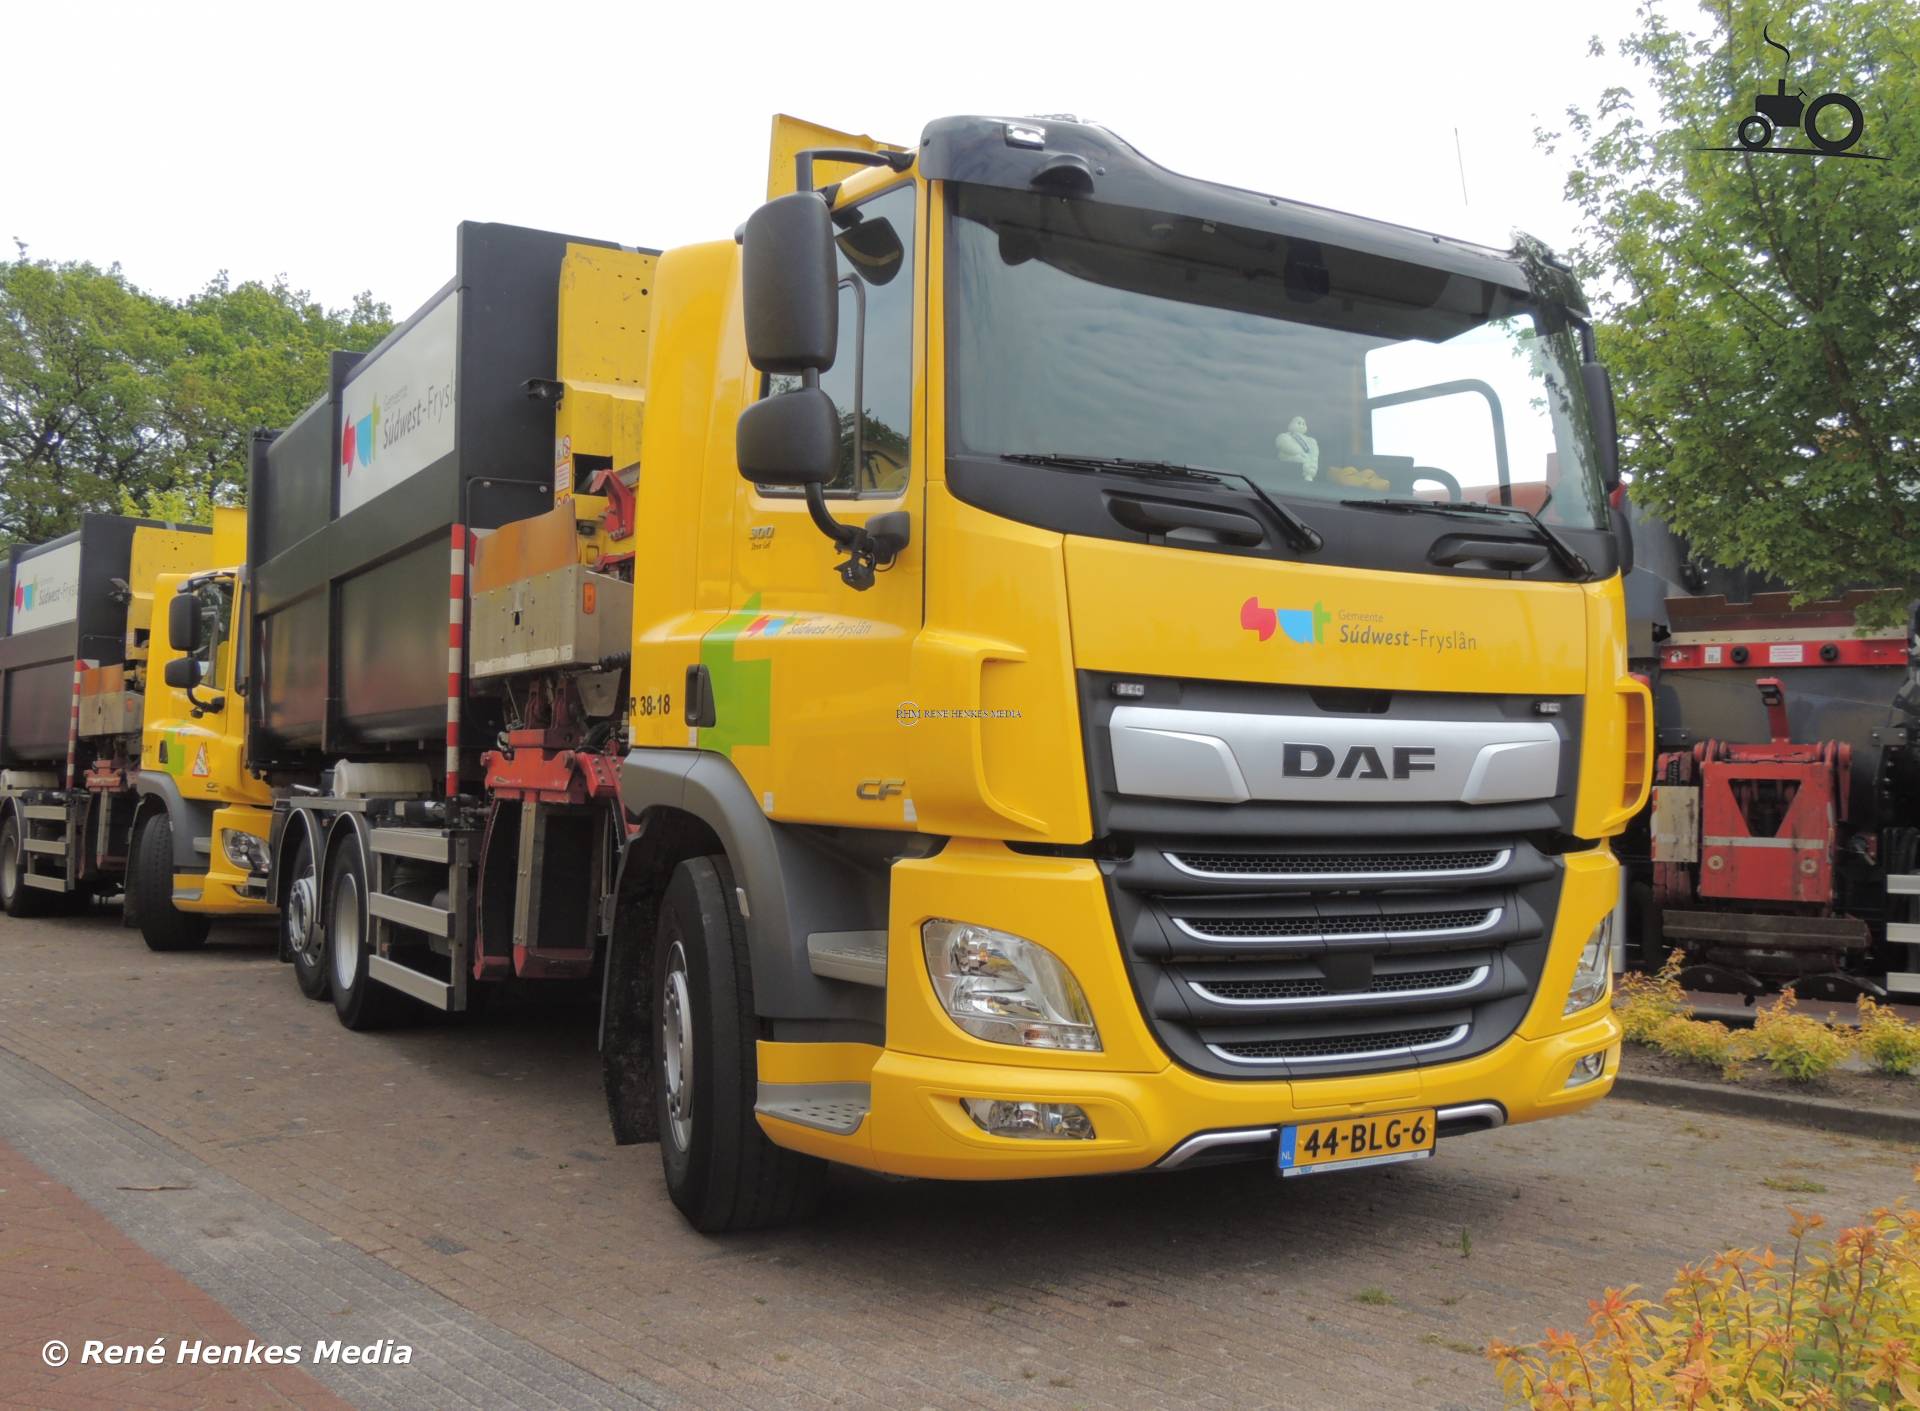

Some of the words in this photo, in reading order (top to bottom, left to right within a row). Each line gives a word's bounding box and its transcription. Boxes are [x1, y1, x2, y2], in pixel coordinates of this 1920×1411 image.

[384, 369, 454, 449] Súdwest-Frysl
[1340, 624, 1477, 653] Súdwest-Fryslân
[640, 694, 671, 716] 38-18
[1282, 743, 1435, 779] DAF
[857, 778, 905, 800] CF
[1303, 1116, 1426, 1158] 44-BLG-6
[1281, 1151, 1292, 1160] NL
